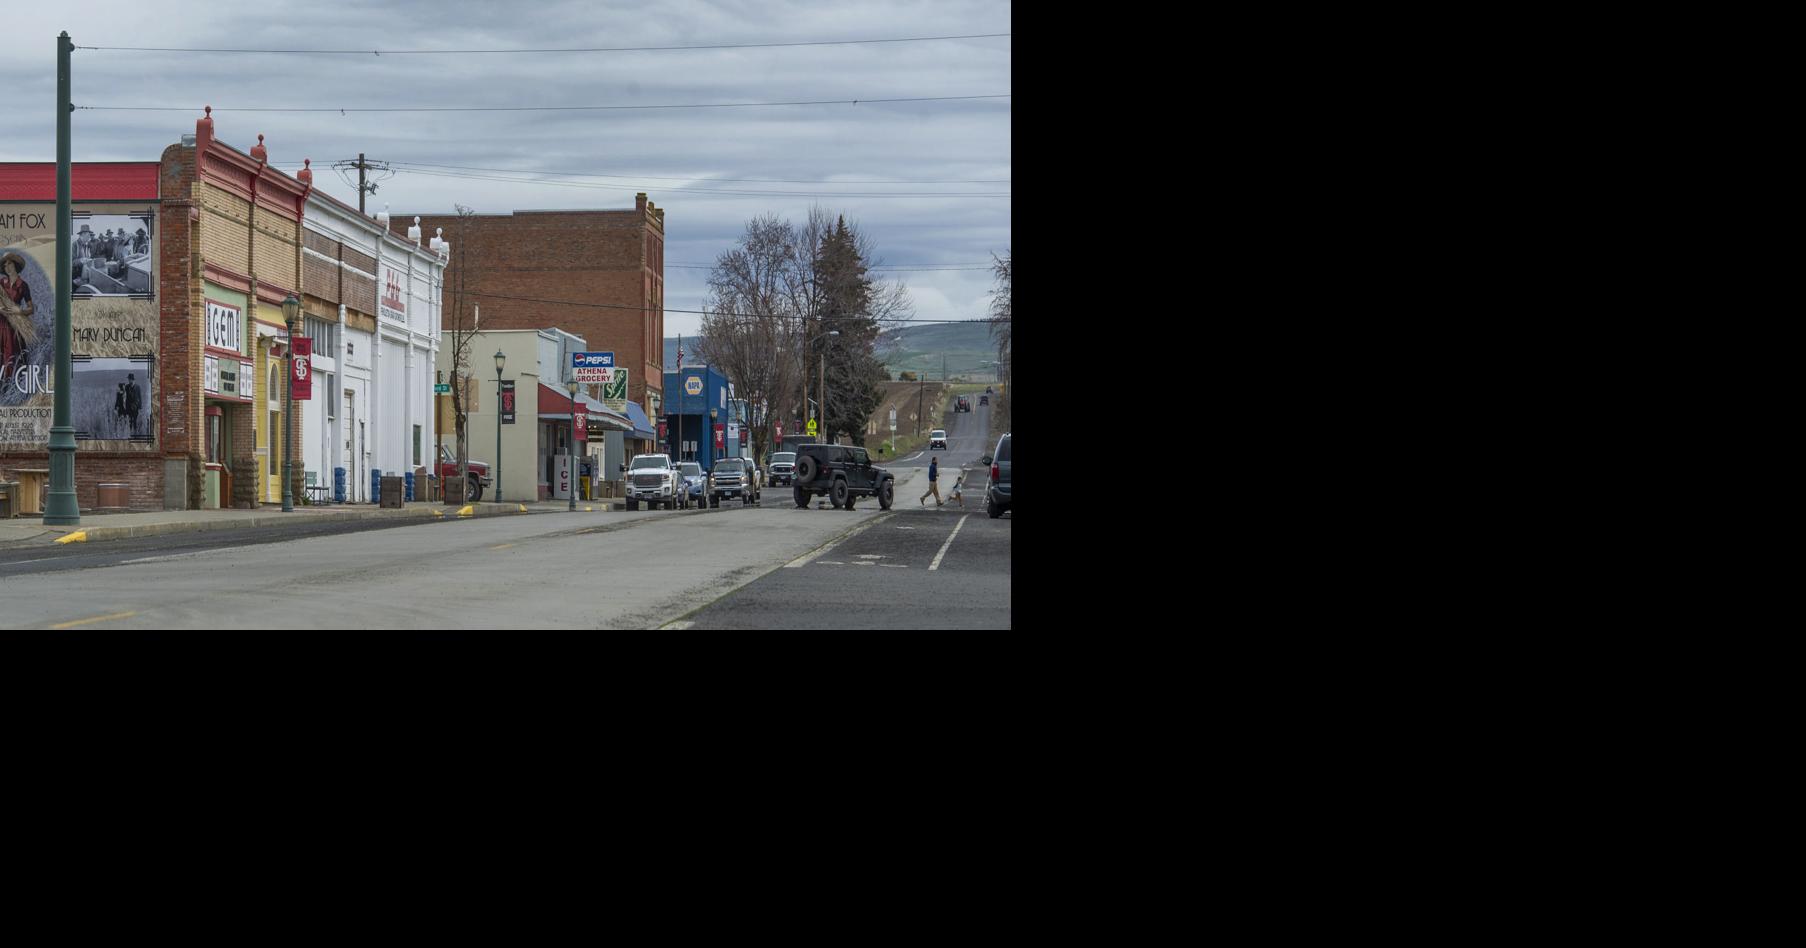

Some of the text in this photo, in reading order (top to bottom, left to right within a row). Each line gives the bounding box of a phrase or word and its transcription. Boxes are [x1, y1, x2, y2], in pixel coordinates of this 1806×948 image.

[19, 213, 46, 229] FOX
[73, 327, 145, 342] MARY DUNCAN
[213, 307, 234, 347] GEM
[586, 356, 611, 364] PEPSI
[15, 364, 54, 395] GIRL
[10, 408, 52, 418] PRODUCTION
